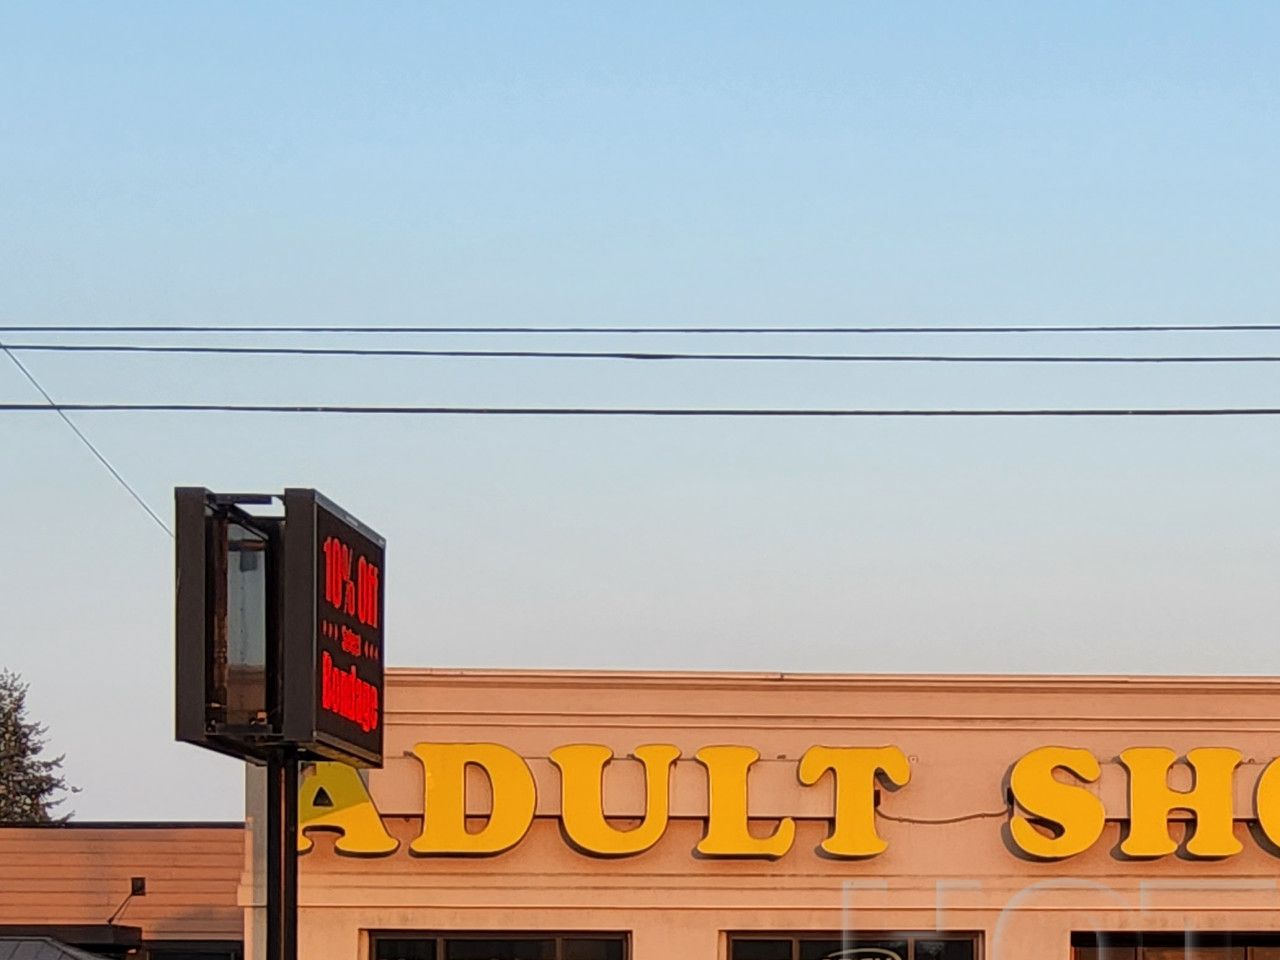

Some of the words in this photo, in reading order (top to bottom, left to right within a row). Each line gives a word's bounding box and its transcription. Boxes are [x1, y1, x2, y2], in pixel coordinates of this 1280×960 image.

[323, 536, 355, 616] 10%
[358, 555, 378, 629] Off
[322, 650, 378, 732] Bondage
[297, 743, 911, 857] ADULT
